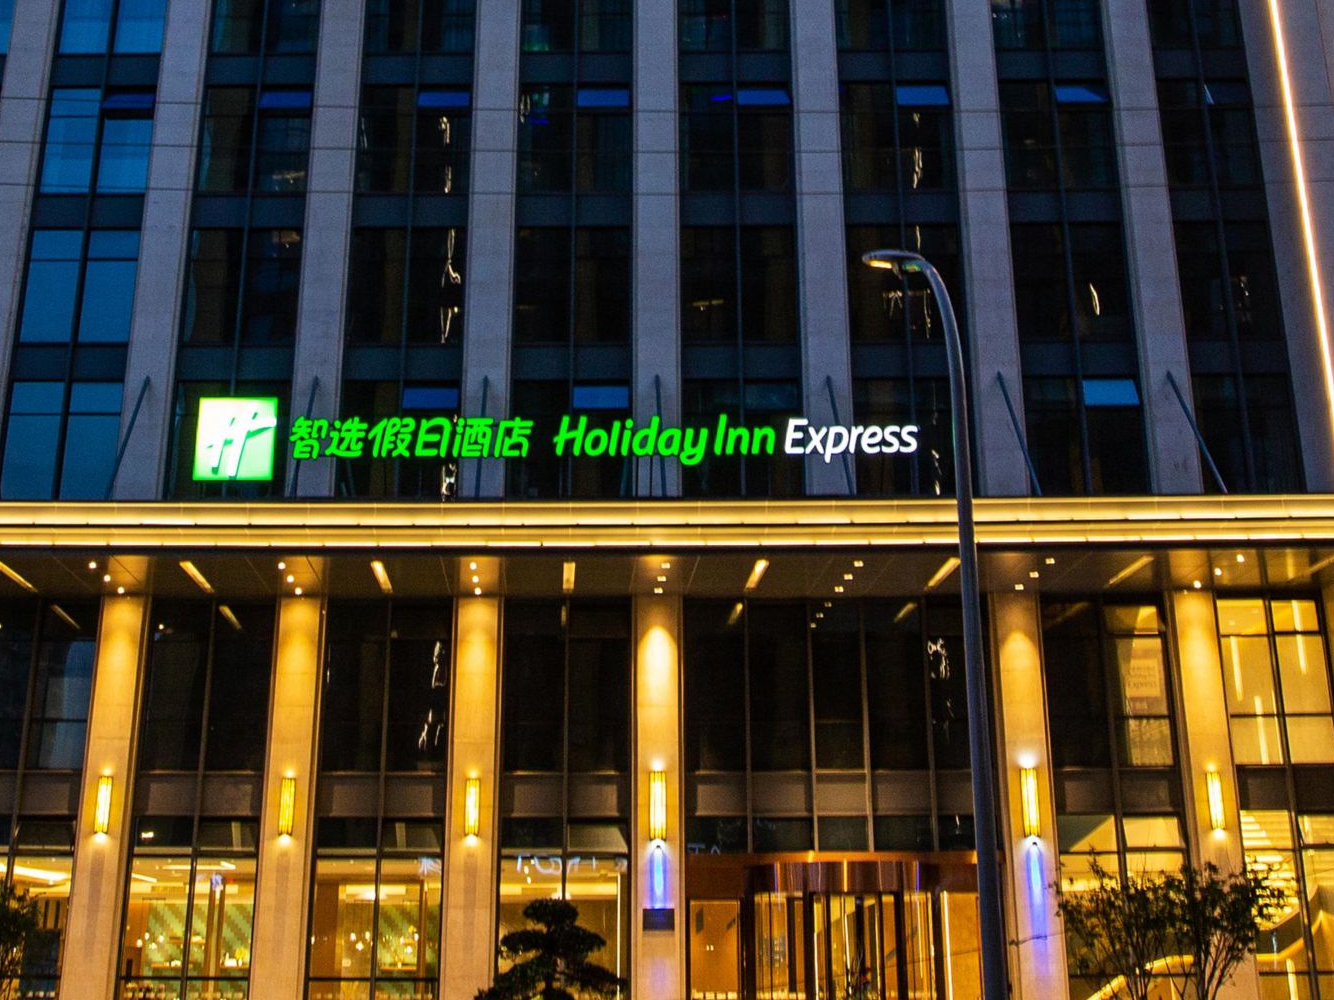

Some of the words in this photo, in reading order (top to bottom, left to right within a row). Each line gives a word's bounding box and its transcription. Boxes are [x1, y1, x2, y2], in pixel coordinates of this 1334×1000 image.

[289, 415, 534, 460] 智选假日酒店
[553, 414, 710, 466] Holiday
[712, 413, 776, 456] Inn
[784, 418, 918, 463] Express
